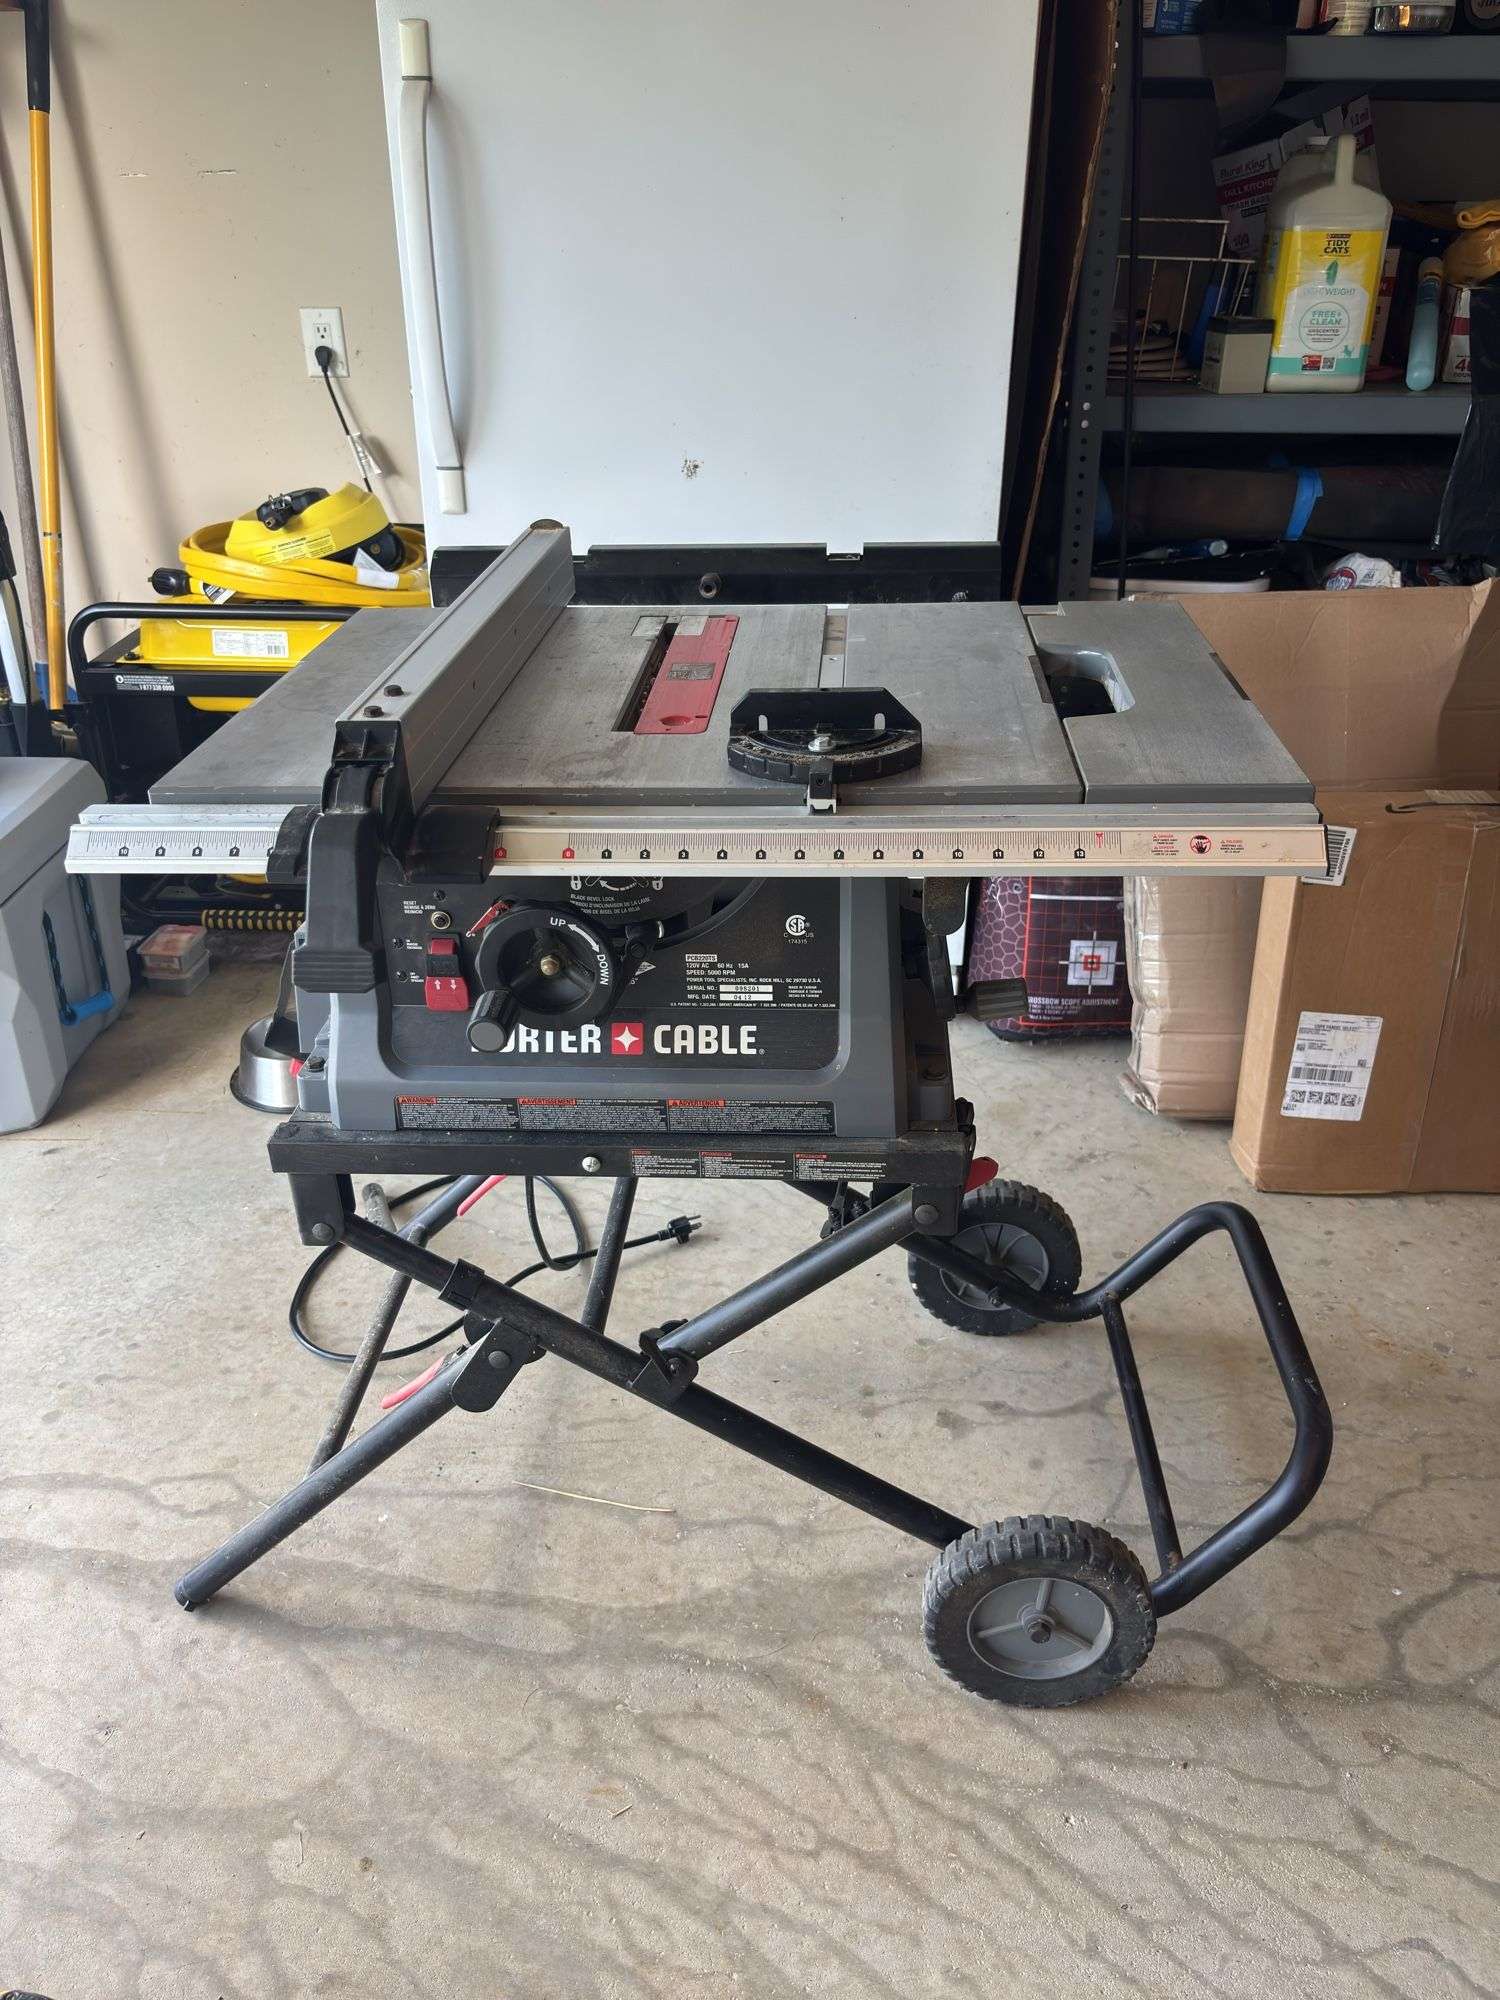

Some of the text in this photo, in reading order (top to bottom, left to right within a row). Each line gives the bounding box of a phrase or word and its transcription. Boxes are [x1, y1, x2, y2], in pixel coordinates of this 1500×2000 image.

[1324, 247, 1350, 255] CATS
[550, 917, 566, 927] UP
[597, 954, 610, 985] DOWN
[1061, 997, 1080, 1005] SCOPE
[1082, 998, 1119, 1006] ADJUSTMENT
[653, 1024, 757, 1055] CABLE
